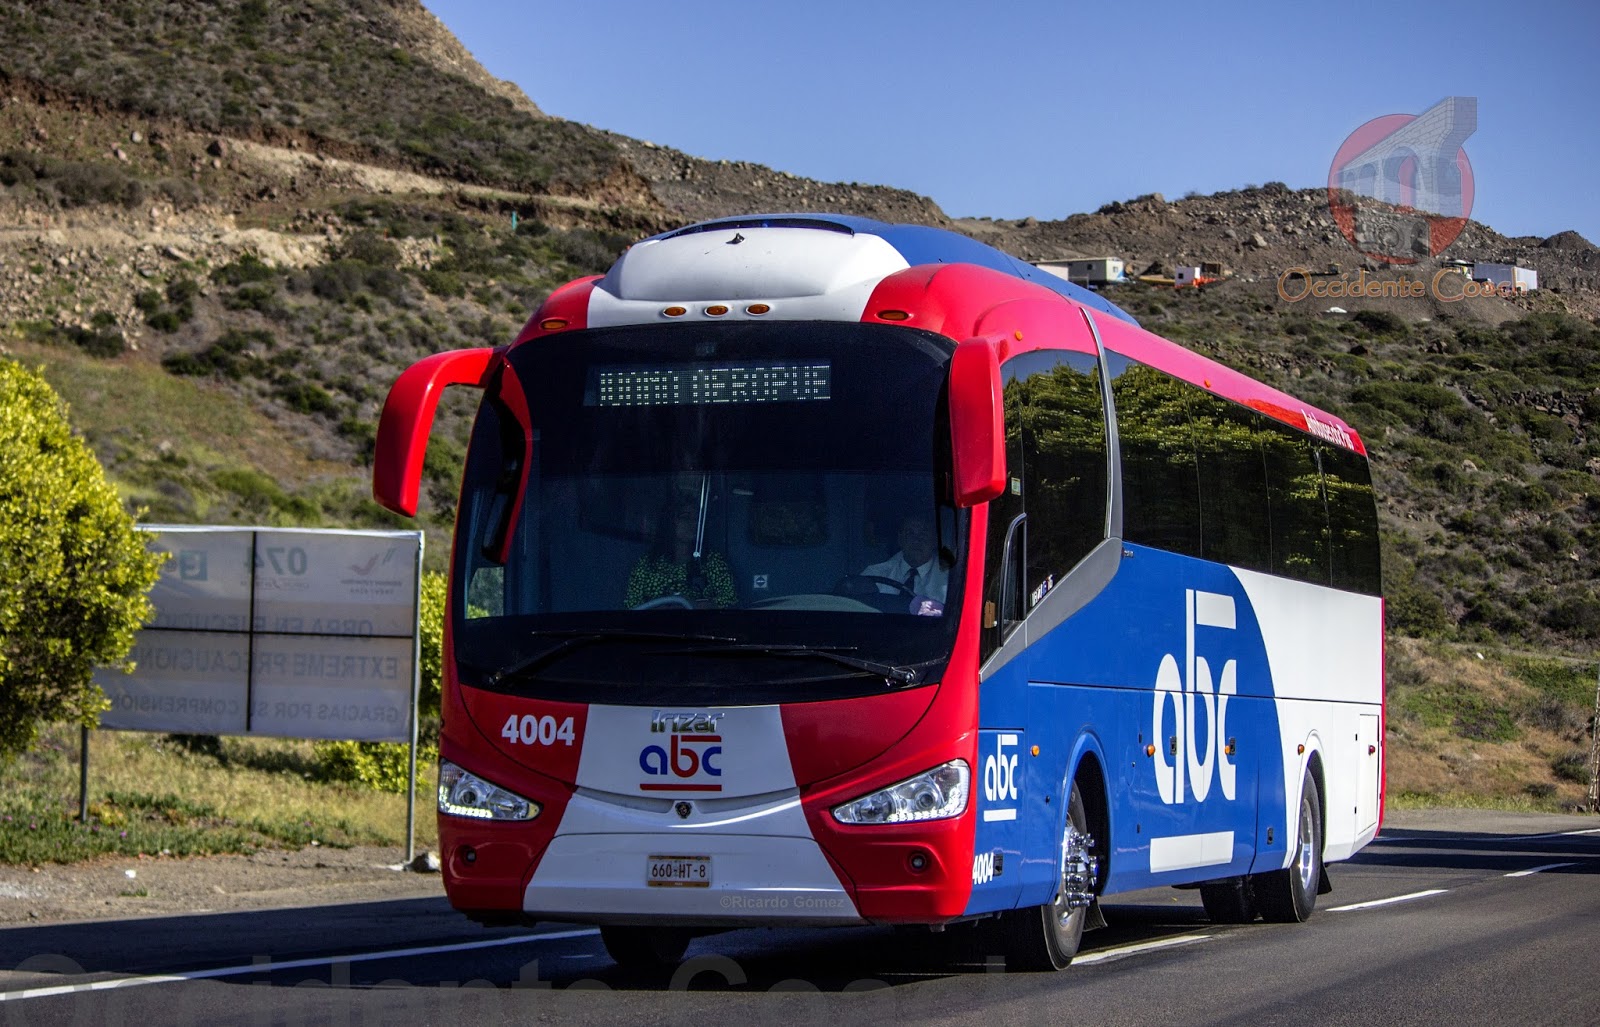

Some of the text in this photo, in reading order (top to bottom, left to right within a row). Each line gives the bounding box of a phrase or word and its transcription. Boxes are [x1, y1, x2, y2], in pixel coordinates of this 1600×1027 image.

[1153, 589, 1236, 804] abc
[502, 714, 575, 746] 4004
[639, 734, 722, 778] abc
[984, 734, 1017, 802] abc
[652, 863, 706, 878] 660-HT-8
[972, 852, 994, 885] 4004
